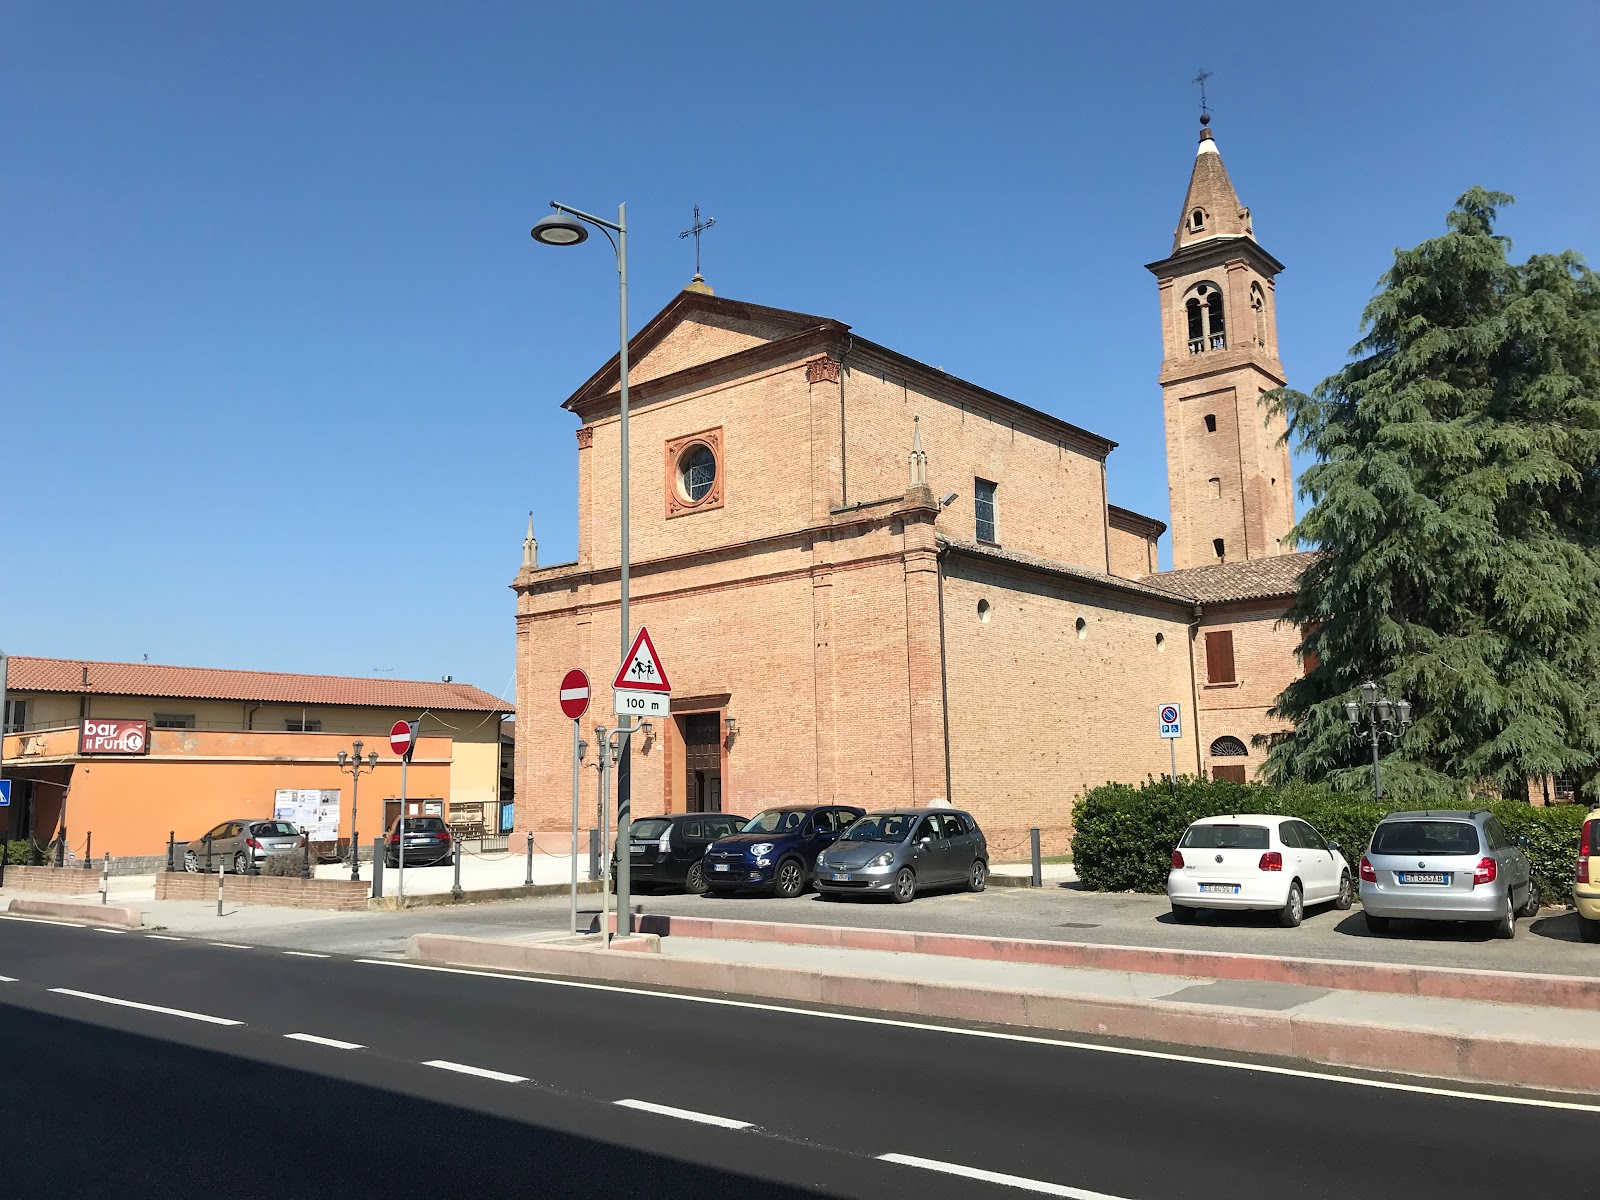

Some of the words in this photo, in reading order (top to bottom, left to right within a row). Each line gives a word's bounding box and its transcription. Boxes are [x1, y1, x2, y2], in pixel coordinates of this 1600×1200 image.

[626, 697, 645, 709] 100
[651, 702, 659, 710] m
[84, 720, 118, 737] bar
[85, 739, 93, 750] il
